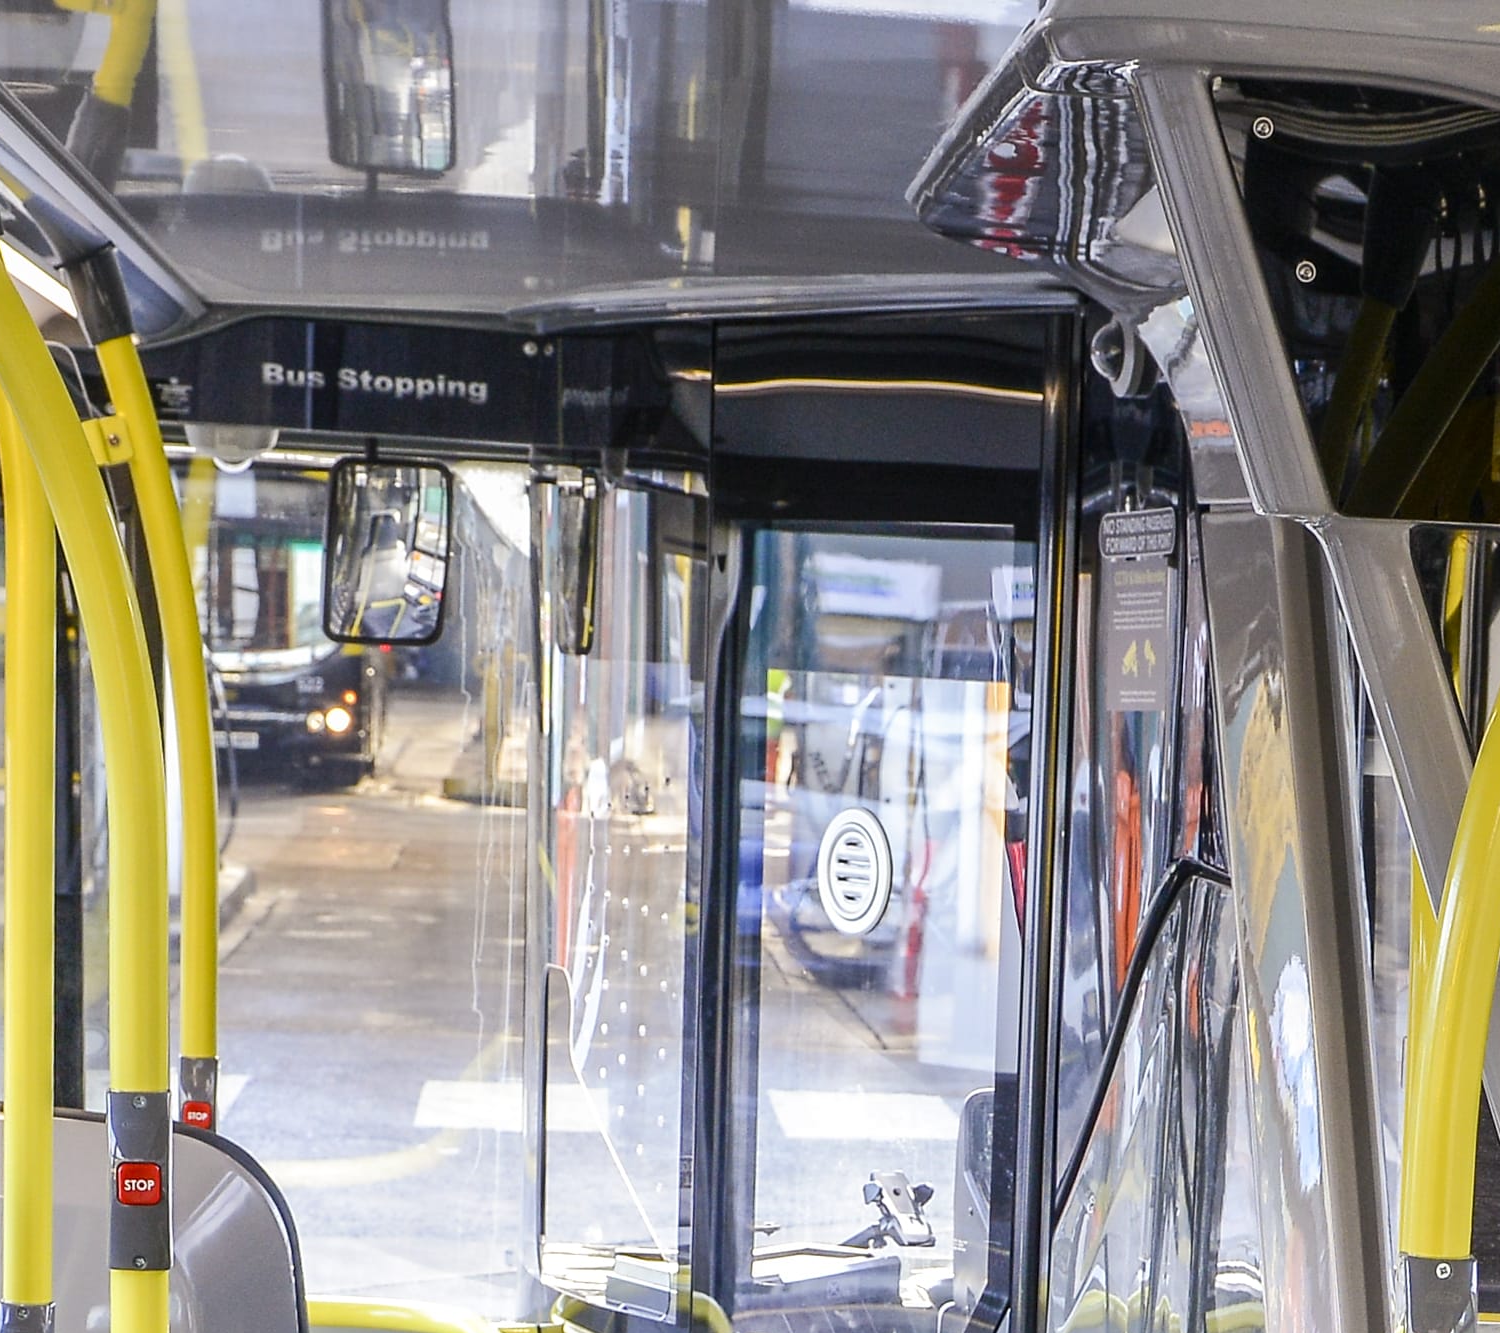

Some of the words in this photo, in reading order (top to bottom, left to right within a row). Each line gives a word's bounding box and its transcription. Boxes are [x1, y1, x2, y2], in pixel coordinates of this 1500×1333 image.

[261, 362, 327, 389] Bus
[337, 368, 489, 405] Stopping
[187, 1109, 208, 1122] STOP
[123, 1178, 155, 1193] STOP
